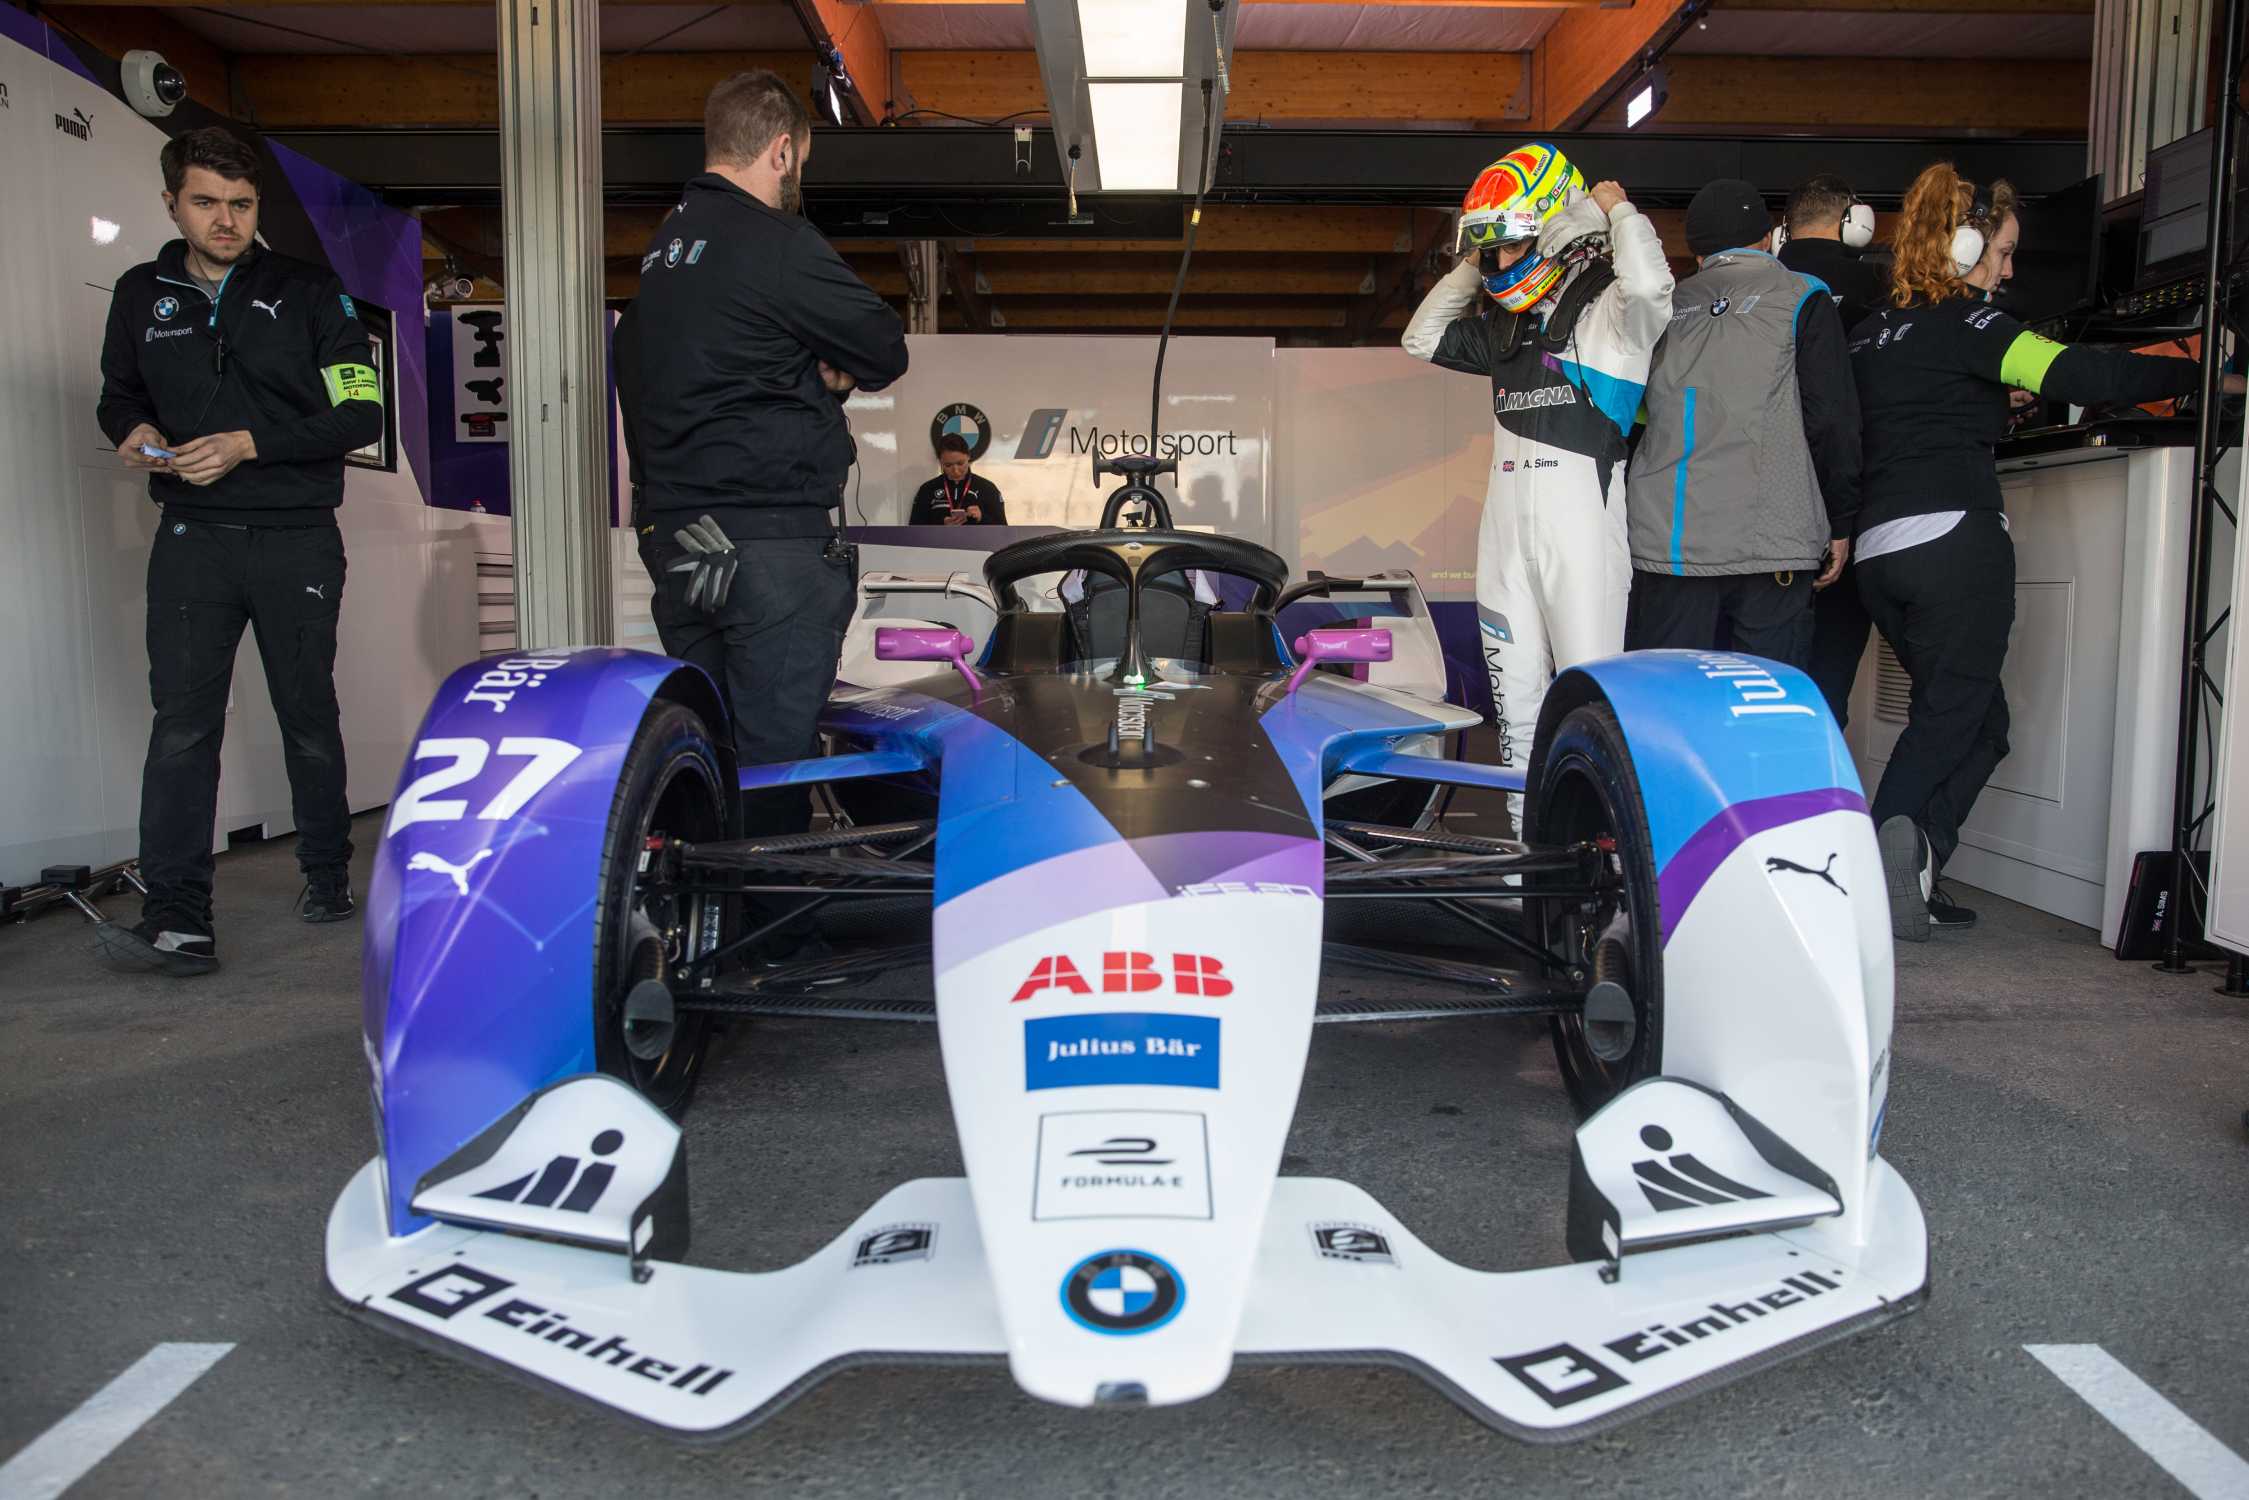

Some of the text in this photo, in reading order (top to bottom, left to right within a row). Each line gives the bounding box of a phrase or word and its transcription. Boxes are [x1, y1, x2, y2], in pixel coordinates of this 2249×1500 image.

[55, 113, 87, 142] PUMA
[1506, 385, 1576, 410] MAGNA
[936, 405, 986, 425] BMW
[1070, 426, 1237, 461] Motosport
[1534, 457, 1559, 469] Sims
[388, 737, 583, 837] 27
[1011, 951, 1235, 1002] ABB
[1048, 1037, 1202, 1061] Julius Bär
[1060, 1175, 1165, 1188] FORMULA
[1603, 1271, 1839, 1364] Einhell
[484, 1299, 733, 1396] Einhell
